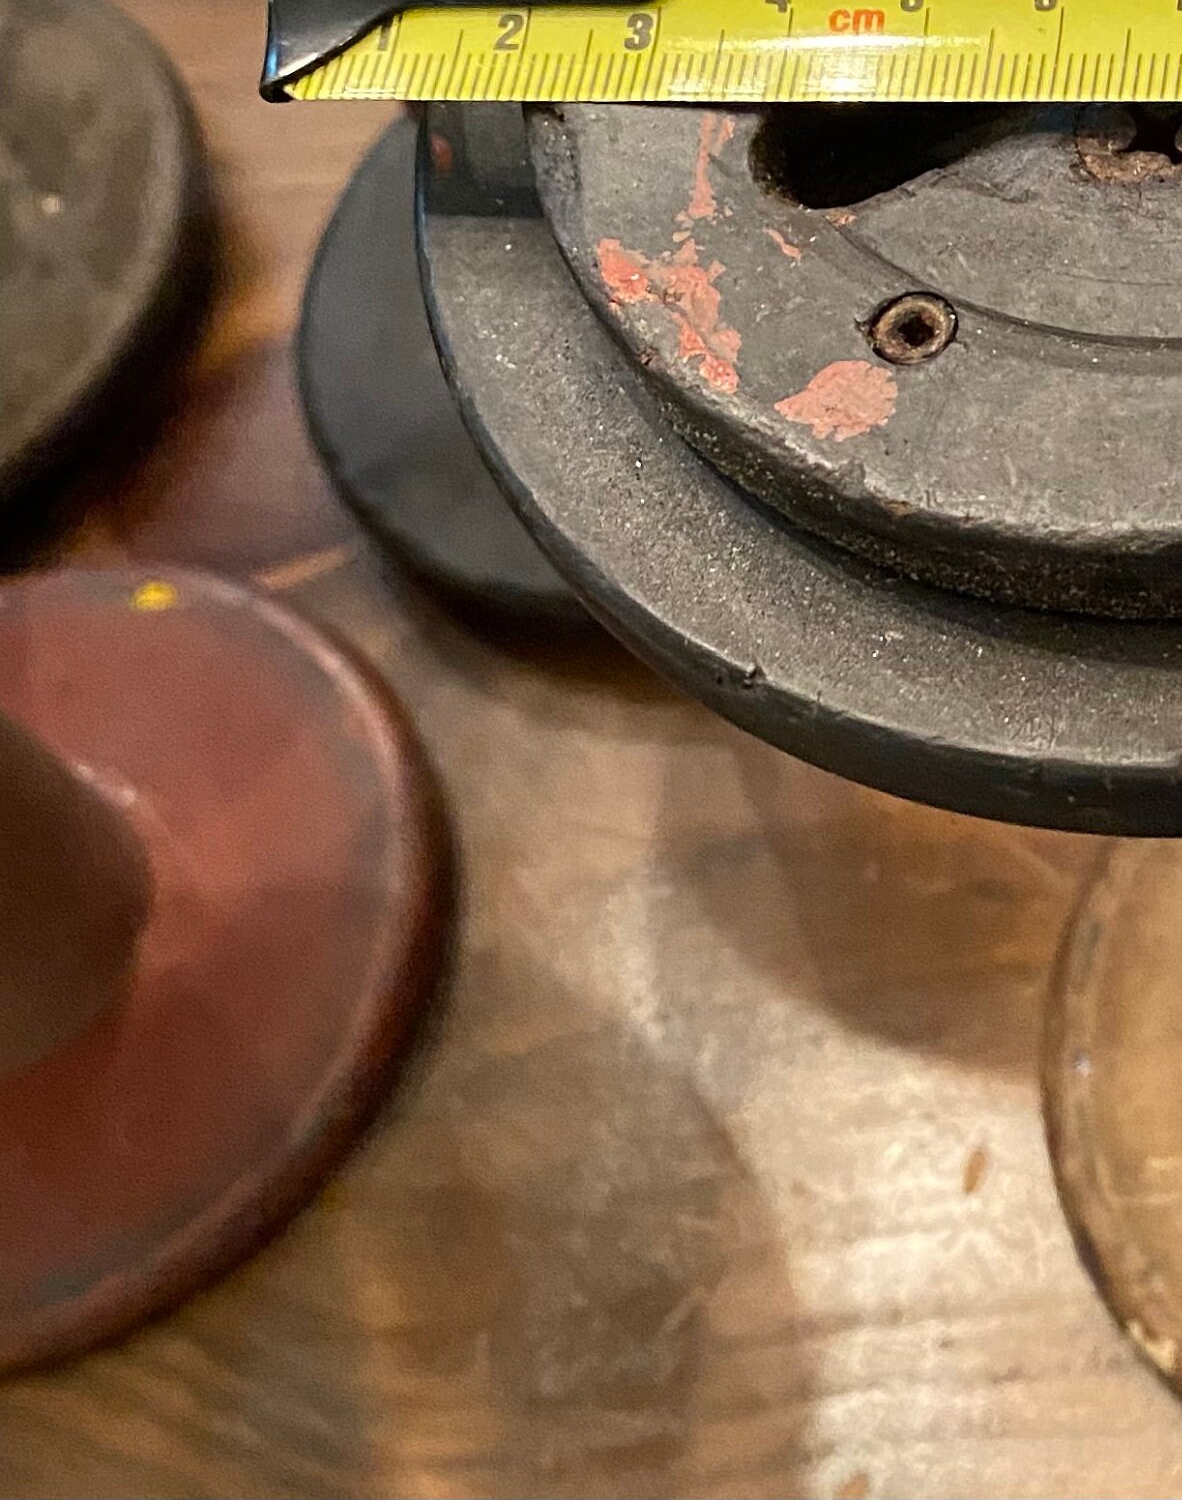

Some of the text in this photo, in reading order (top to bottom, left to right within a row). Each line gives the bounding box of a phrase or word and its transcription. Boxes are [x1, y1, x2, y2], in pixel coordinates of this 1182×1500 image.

[493, 14, 524, 51] 2
[624, 13, 655, 50] 3
[829, 8, 885, 35] cm
